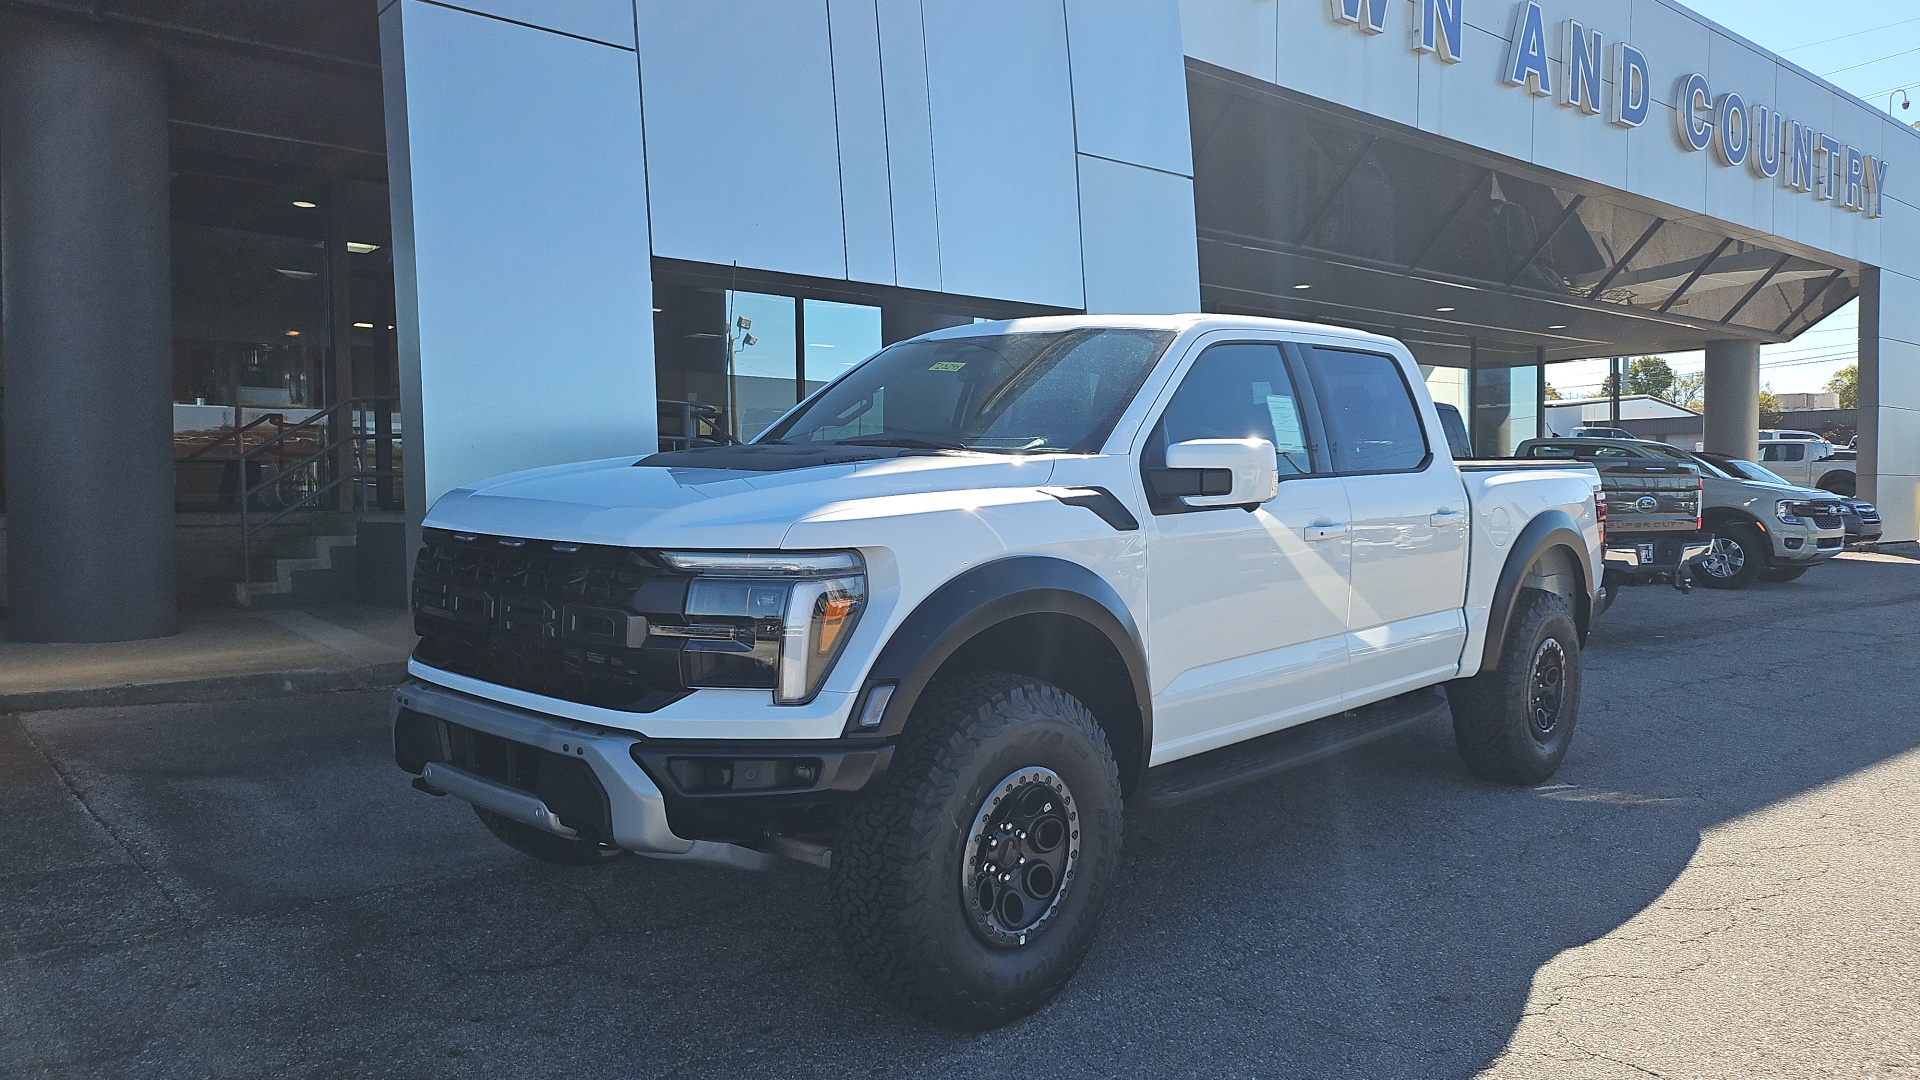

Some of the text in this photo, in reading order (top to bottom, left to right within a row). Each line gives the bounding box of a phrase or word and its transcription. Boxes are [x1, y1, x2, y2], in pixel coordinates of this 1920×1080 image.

[1504, 0, 1651, 129] AND
[1676, 72, 1888, 219] COUNTRY
[1607, 520, 1684, 530] SUPER DUTY
